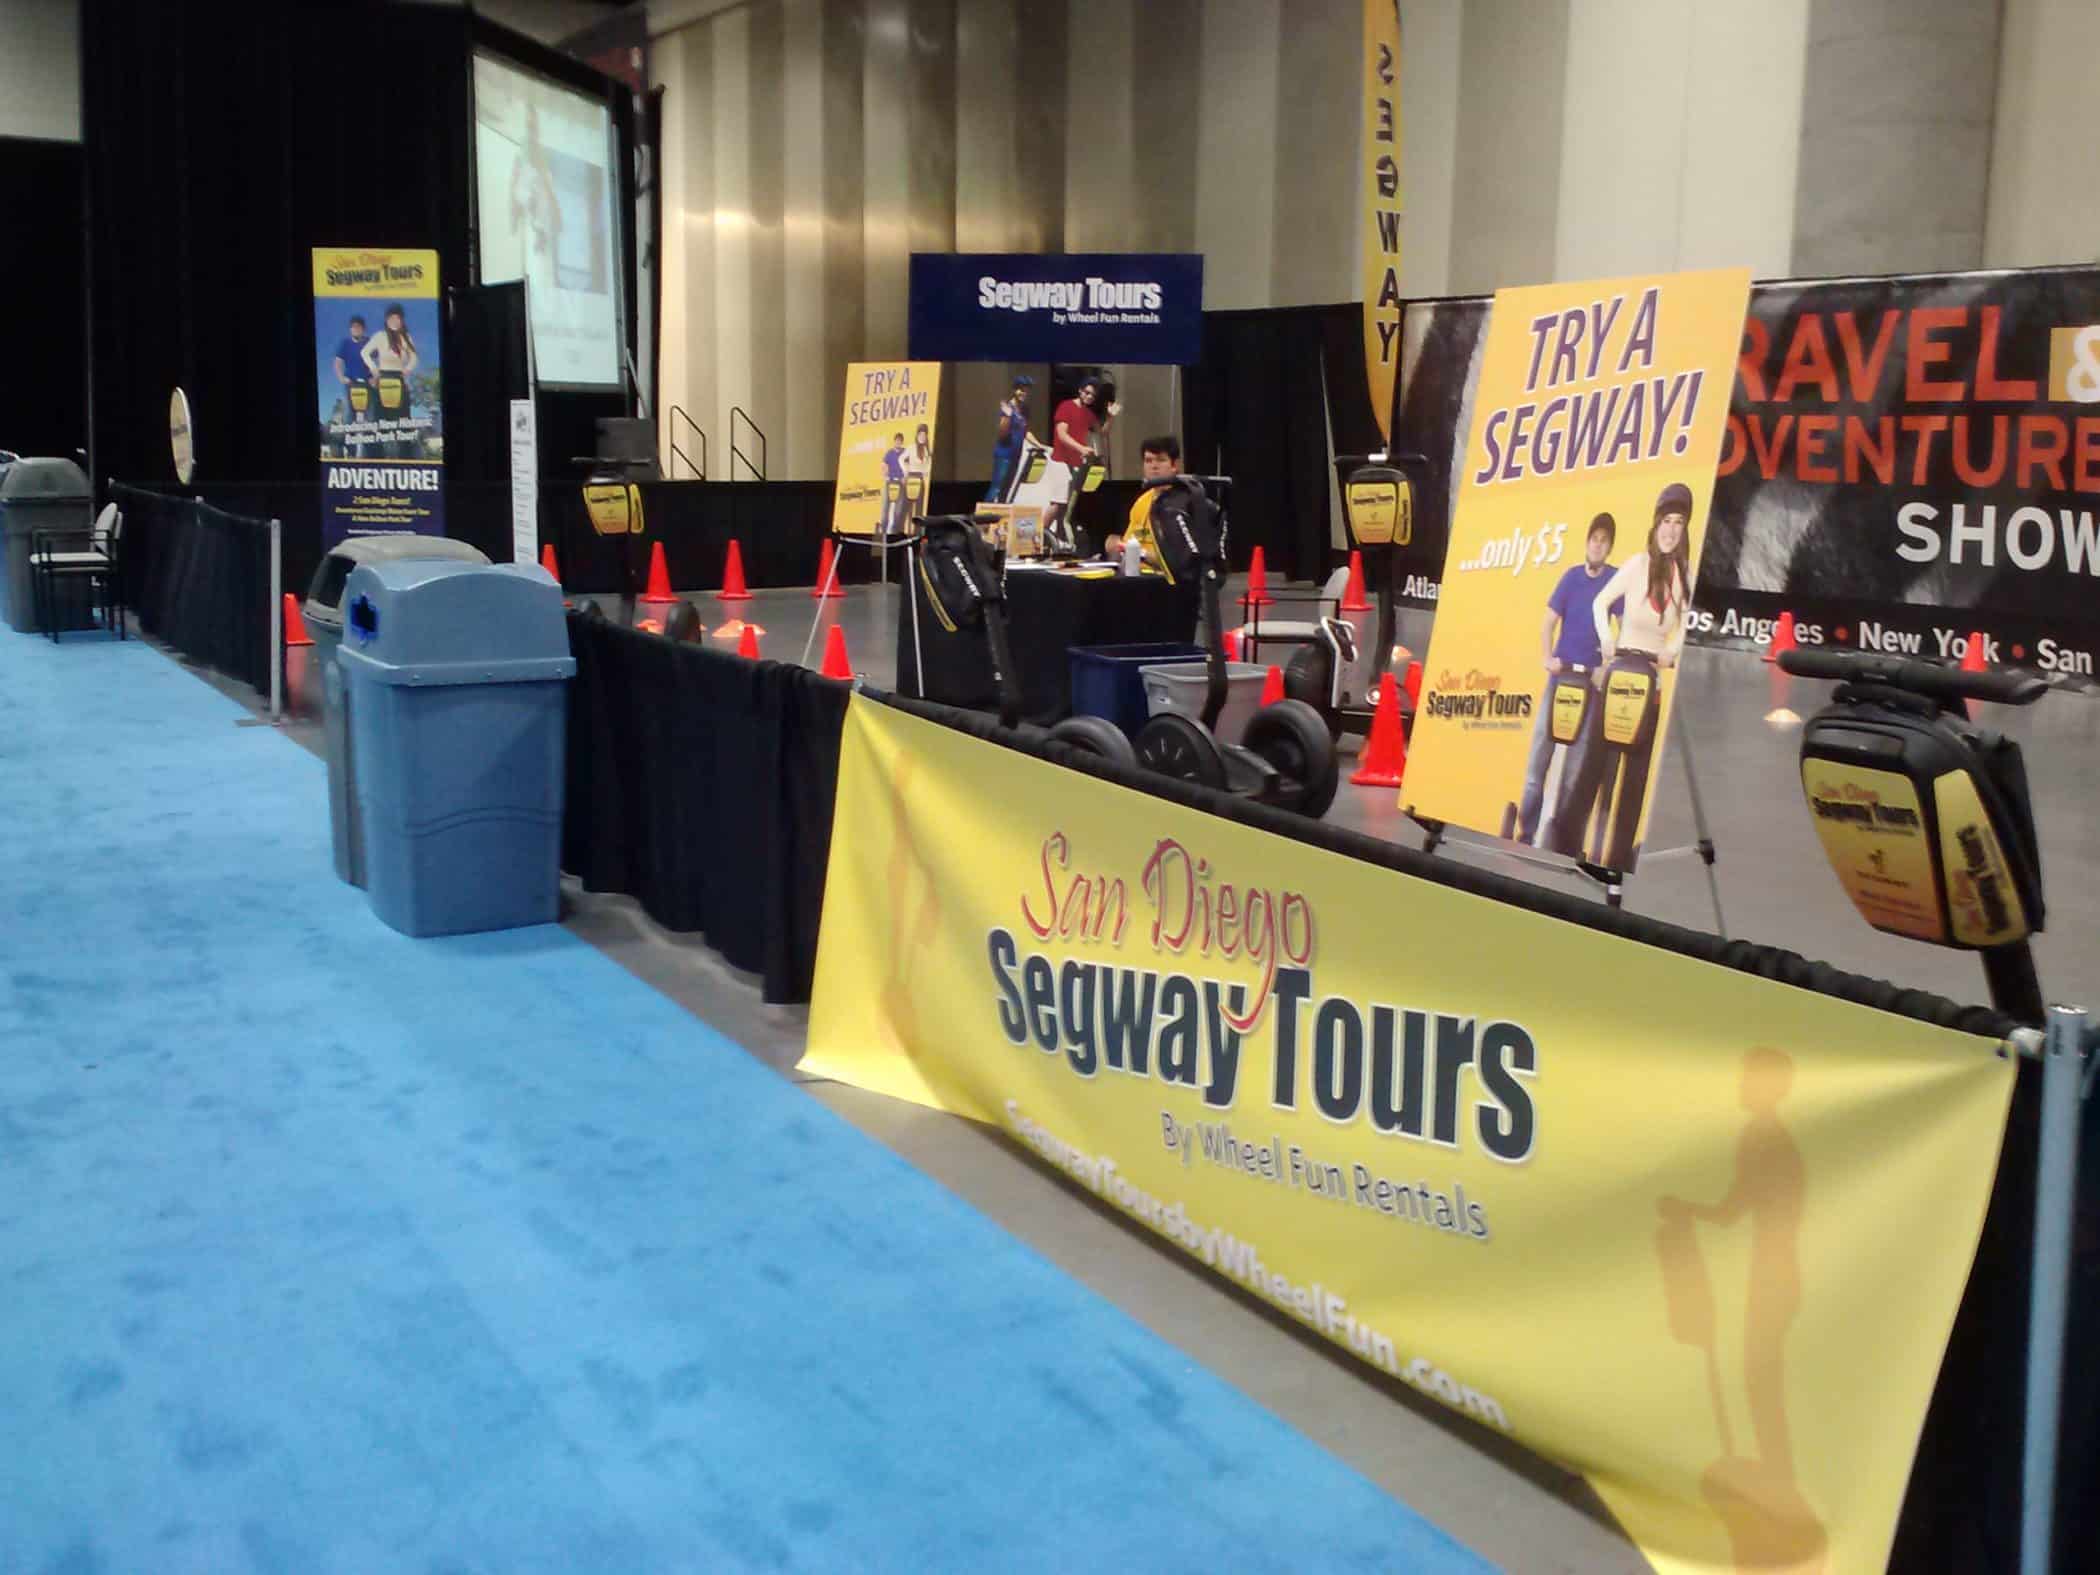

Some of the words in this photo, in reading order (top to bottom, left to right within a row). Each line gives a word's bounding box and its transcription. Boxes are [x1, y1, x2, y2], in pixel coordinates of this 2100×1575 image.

[978, 276, 1084, 313] Segway
[1085, 277, 1162, 310] Tours
[1052, 312, 1066, 325] by
[1067, 312, 1099, 324] Wheel
[1524, 295, 1624, 393] TRY
[1617, 286, 1661, 374] A
[1736, 304, 2039, 403] RAVEL
[849, 391, 928, 426] SEGWAY!
[864, 369, 896, 397] TRY
[900, 367, 911, 390] A
[1473, 369, 1705, 487] SEGWAY!
[327, 466, 440, 491] ADVENTURE!
[1534, 520, 1569, 567] $5
[1402, 574, 1441, 600] Atla
[1686, 610, 1715, 632] os
[1720, 608, 1825, 645] Anges
[1858, 620, 1923, 655] New
[1932, 627, 2001, 663] Yok
[2036, 638, 2094, 675] San
[1426, 690, 1486, 719] Segway
[1486, 688, 1533, 718] Tours
[1020, 830, 1129, 945] San
[1141, 837, 1314, 1032] Diego
[987, 926, 1248, 1109] Segway
[1269, 964, 1540, 1165] Tours
[1161, 1111, 1194, 1165] By
[1197, 1119, 1284, 1184] Wheel
[1288, 1146, 1349, 1200] Fun
[1352, 1161, 1491, 1241] Rentals
